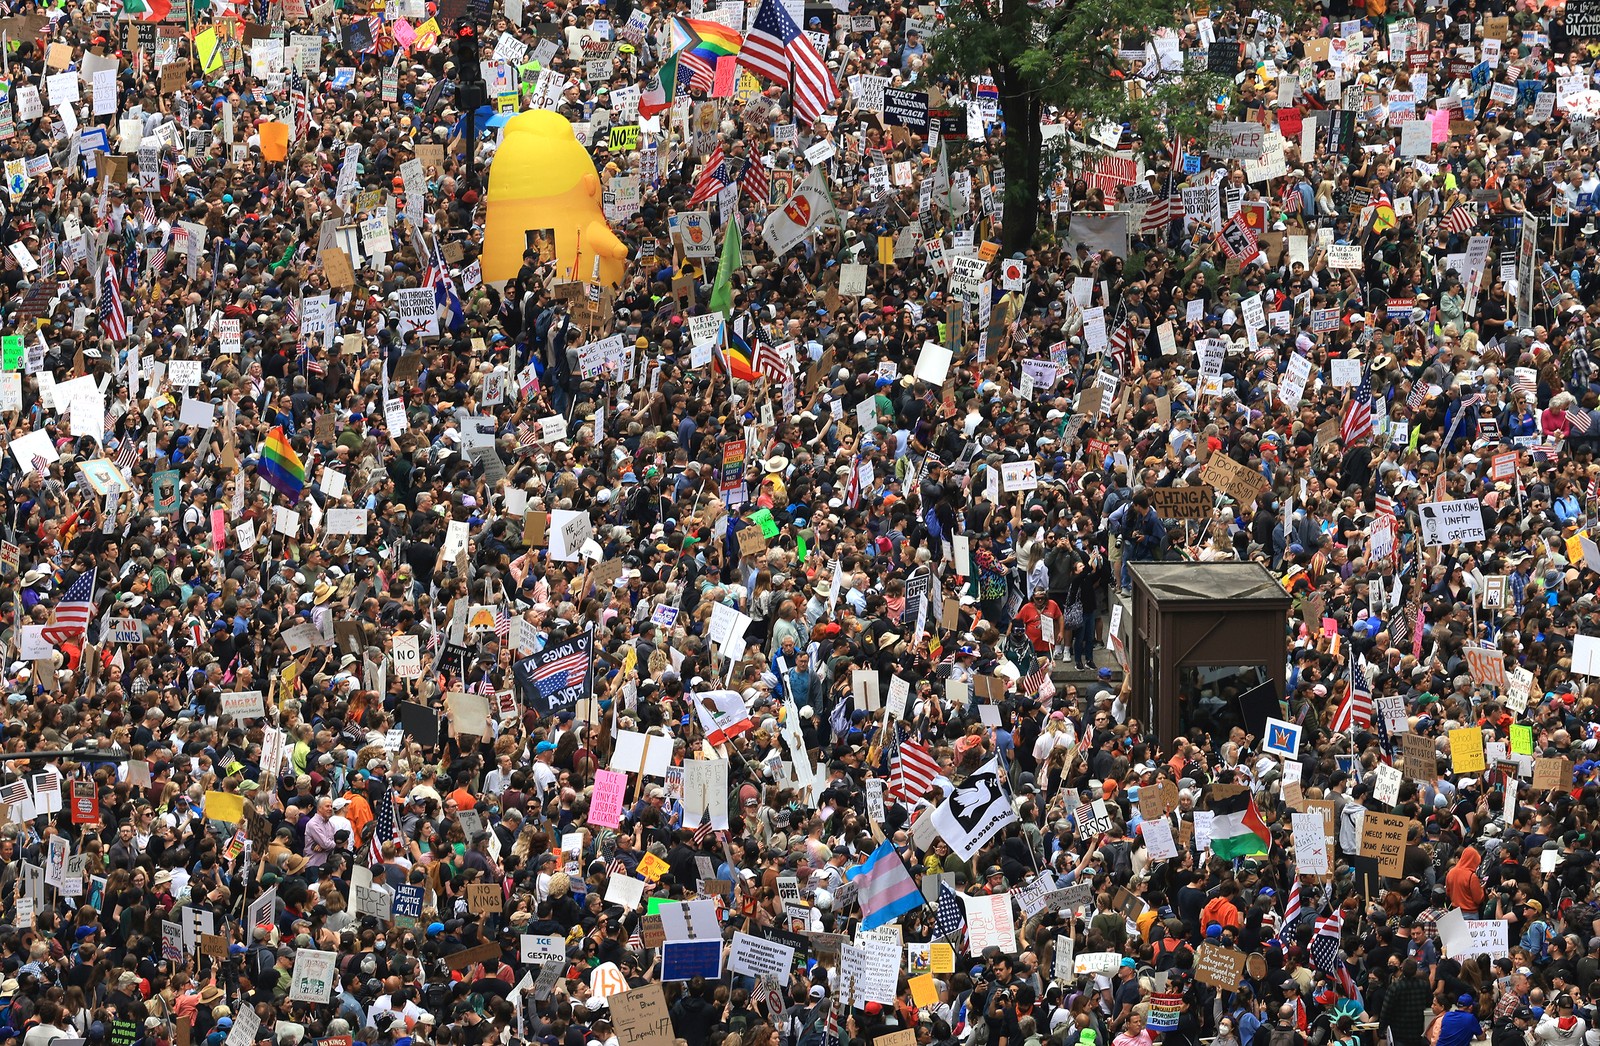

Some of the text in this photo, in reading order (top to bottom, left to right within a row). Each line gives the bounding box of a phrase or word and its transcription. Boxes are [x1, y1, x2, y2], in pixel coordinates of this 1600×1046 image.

[505, 37, 527, 54] FUCK
[589, 71, 611, 79] CRUELTY
[863, 83, 885, 92] HATES
[885, 89, 916, 99] REJECT
[866, 102, 882, 110] GREAT
[892, 98, 927, 109] FASCISM
[885, 106, 924, 118] IMPEACH
[897, 116, 926, 125] TRUMP
[609, 130, 626, 148] NO
[697, 142, 715, 155] KING
[871, 171, 887, 179] PEOPLE
[1184, 190, 1193, 198] NO
[1184, 198, 1194, 206] NO
[1185, 206, 1197, 214] NO
[926, 240, 940, 249] THE
[957, 257, 984, 270] THE ONLY
[954, 267, 968, 277] KING
[952, 274, 980, 285] RECOGNIZE
[408, 290, 433, 299] THRONES
[409, 297, 434, 306] CROWNS
[401, 305, 435, 317] NO KINGS
[1314, 312, 1324, 321] WE
[694, 315, 714, 325] VETS
[1314, 319, 1338, 330] PEOPLE
[693, 320, 720, 332] AGAINST
[599, 341, 613, 350] LIKE
[583, 355, 600, 364] MILES
[170, 361, 198, 370] MAKE
[1214, 454, 1262, 485] Too Shit
[1203, 466, 1253, 501] For One Sign
[1155, 491, 1210, 505] CHINGA
[1160, 506, 1211, 518] TRUMP
[1440, 502, 1480, 513] FAUX KING
[566, 519, 582, 535] HE IS
[1444, 516, 1470, 527] UNFIT
[1447, 530, 1483, 540] GRIFTER
[908, 585, 927, 597] OFF!
[123, 620, 137, 630] NO
[116, 632, 141, 642] KINGS
[397, 649, 415, 660] NO
[395, 664, 420, 675] KINGS
[1469, 650, 1504, 687] 8647
[224, 697, 258, 708] ANGRY
[1381, 699, 1400, 710] DUE
[1407, 735, 1432, 748] UNPAID
[605, 773, 618, 782] ICE
[666, 771, 681, 785] FOR
[597, 782, 620, 793] SHOULD
[596, 792, 618, 803] ONLY BE
[594, 802, 617, 814] USED FOR
[1299, 814, 1311, 823] DUE
[1366, 815, 1404, 828] THE WORLD
[1080, 816, 1110, 839] RESIST
[1364, 830, 1402, 840] NEEDS MORE
[1363, 841, 1401, 854] YOUNG ANGRY
[68, 855, 82, 874] FUCK
[398, 886, 417, 895] LIBERTY
[477, 885, 490, 894] NO
[781, 889, 798, 899] OFF!
[356, 887, 387, 906] FUCK
[400, 896, 420, 904] JUSTICE
[473, 895, 500, 908] KINGS
[358, 899, 386, 917] ICE
[404, 904, 419, 917] ALL
[1024, 906, 1037, 916] NOT
[985, 917, 994, 935] ICE
[970, 911, 988, 955] ABOLISH
[209, 936, 219, 944] NO
[536, 937, 551, 945] ICE
[741, 939, 750, 947] First
[751, 941, 761, 950] they
[761, 944, 772, 952] came
[203, 945, 223, 954] KINGS
[527, 952, 563, 961] GESTAPO
[739, 956, 755, 965] Because
[762, 956, 775, 965] speak
[1203, 955, 1224, 967] stranger
[1091, 962, 1110, 972] ICE
[1198, 963, 1207, 971] you
[626, 991, 643, 1003] Free
[640, 1001, 656, 1010] Brave
[112, 1020, 130, 1029] TRUMP
[1152, 1018, 1179, 1026] PATHETIC
[623, 1017, 671, 1043] Impeach 47
[883, 1031, 911, 1045] LIKE MY
